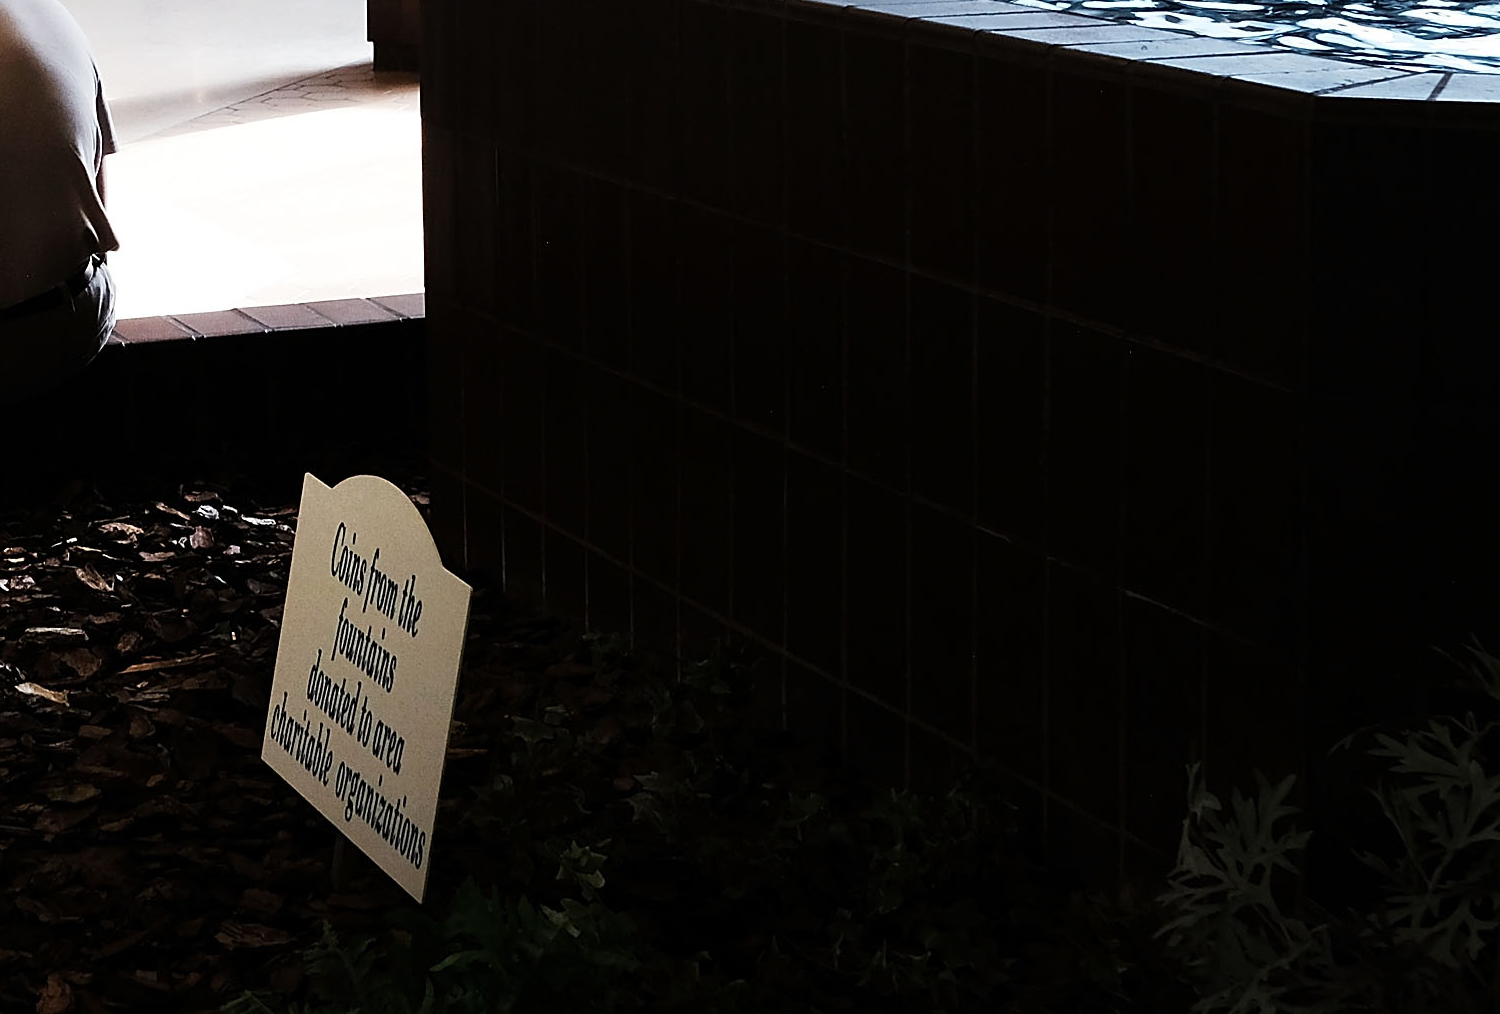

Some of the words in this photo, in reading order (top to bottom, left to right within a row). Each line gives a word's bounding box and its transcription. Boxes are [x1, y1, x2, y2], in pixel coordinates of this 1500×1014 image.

[330, 521, 367, 602] Coins
[362, 548, 399, 621] from
[396, 574, 423, 638] the
[331, 597, 397, 694] fountains
[306, 649, 362, 737] donated
[357, 697, 373, 753] to
[372, 720, 405, 775] area
[270, 691, 334, 787] charitable
[334, 759, 427, 871] organizations
